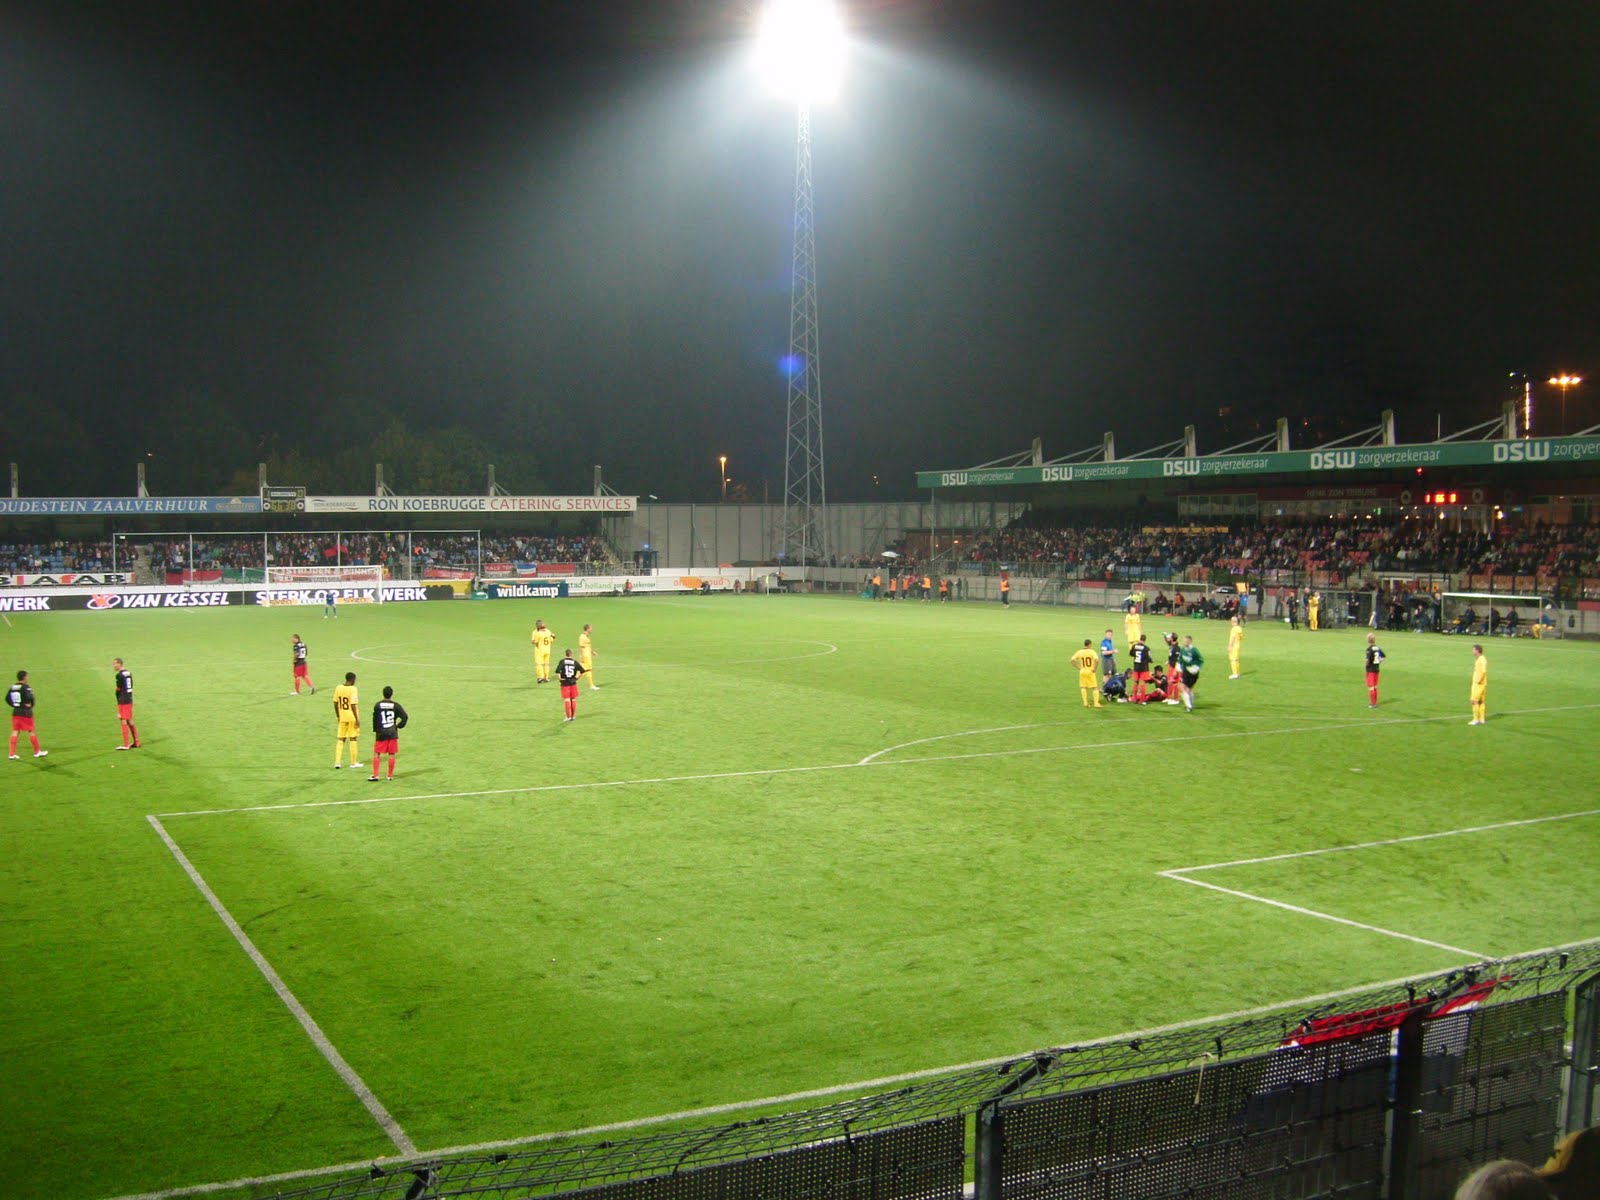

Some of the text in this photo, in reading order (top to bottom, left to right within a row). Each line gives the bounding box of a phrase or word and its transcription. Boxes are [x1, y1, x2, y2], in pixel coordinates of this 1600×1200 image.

[1493, 442, 1549, 462] DSW
[1163, 457, 1268, 476] DSW zorgverzekeraar
[1310, 449, 1440, 470] DSW zorgverzekeraar
[942, 472, 1014, 486] DSW zorgverzekeraar
[1042, 466, 1129, 482] DSW zorgverzekeraar
[93, 500, 208, 512] ZAALVERHUUR
[369, 498, 631, 510] RON KOEBRUGGE CATERING SERVICES
[381, 587, 427, 601] WERK
[497, 583, 559, 598] wildkamp
[123, 592, 229, 607] VAN KESSEL
[1081, 656, 1092, 667] 10
[1134, 651, 1142, 663] 5
[564, 665, 575, 676] 15
[338, 696, 350, 710] 18
[380, 711, 395, 724] 12
